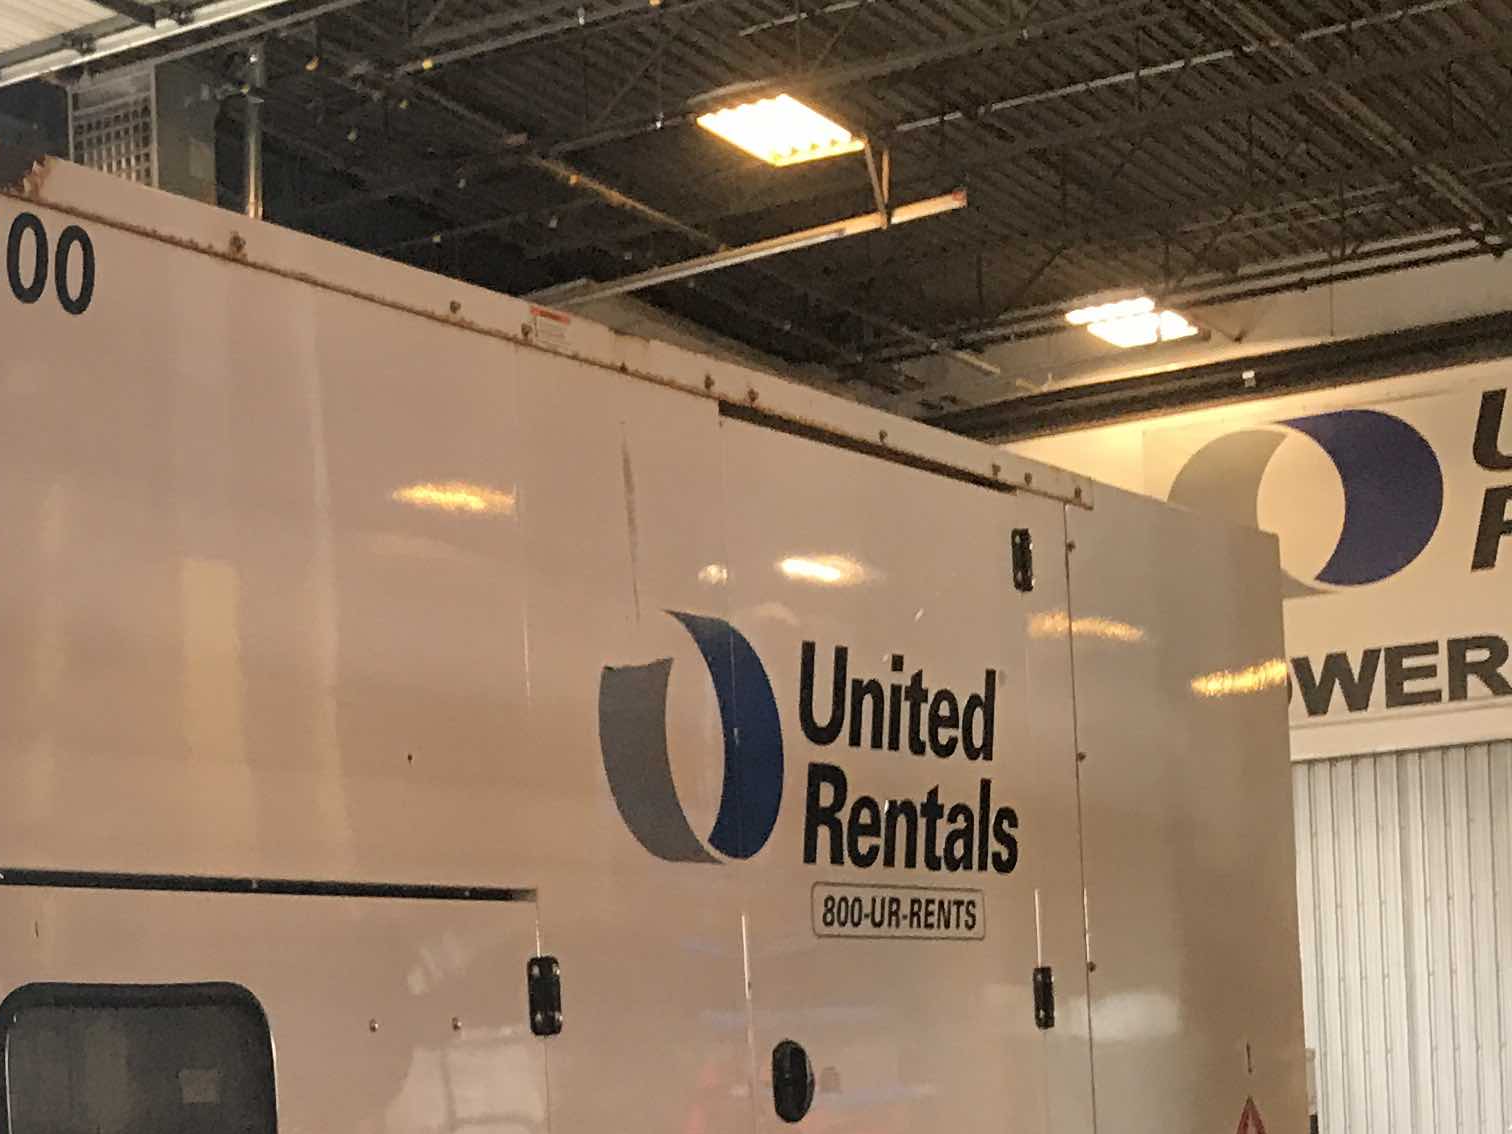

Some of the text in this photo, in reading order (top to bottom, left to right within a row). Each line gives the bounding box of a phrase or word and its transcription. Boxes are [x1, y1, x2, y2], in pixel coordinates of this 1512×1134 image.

[798, 640, 997, 761] United
[1289, 635, 1512, 717] WER
[803, 762, 1018, 874] Rentals
[822, 895, 977, 931] 800-UR-RENTS
